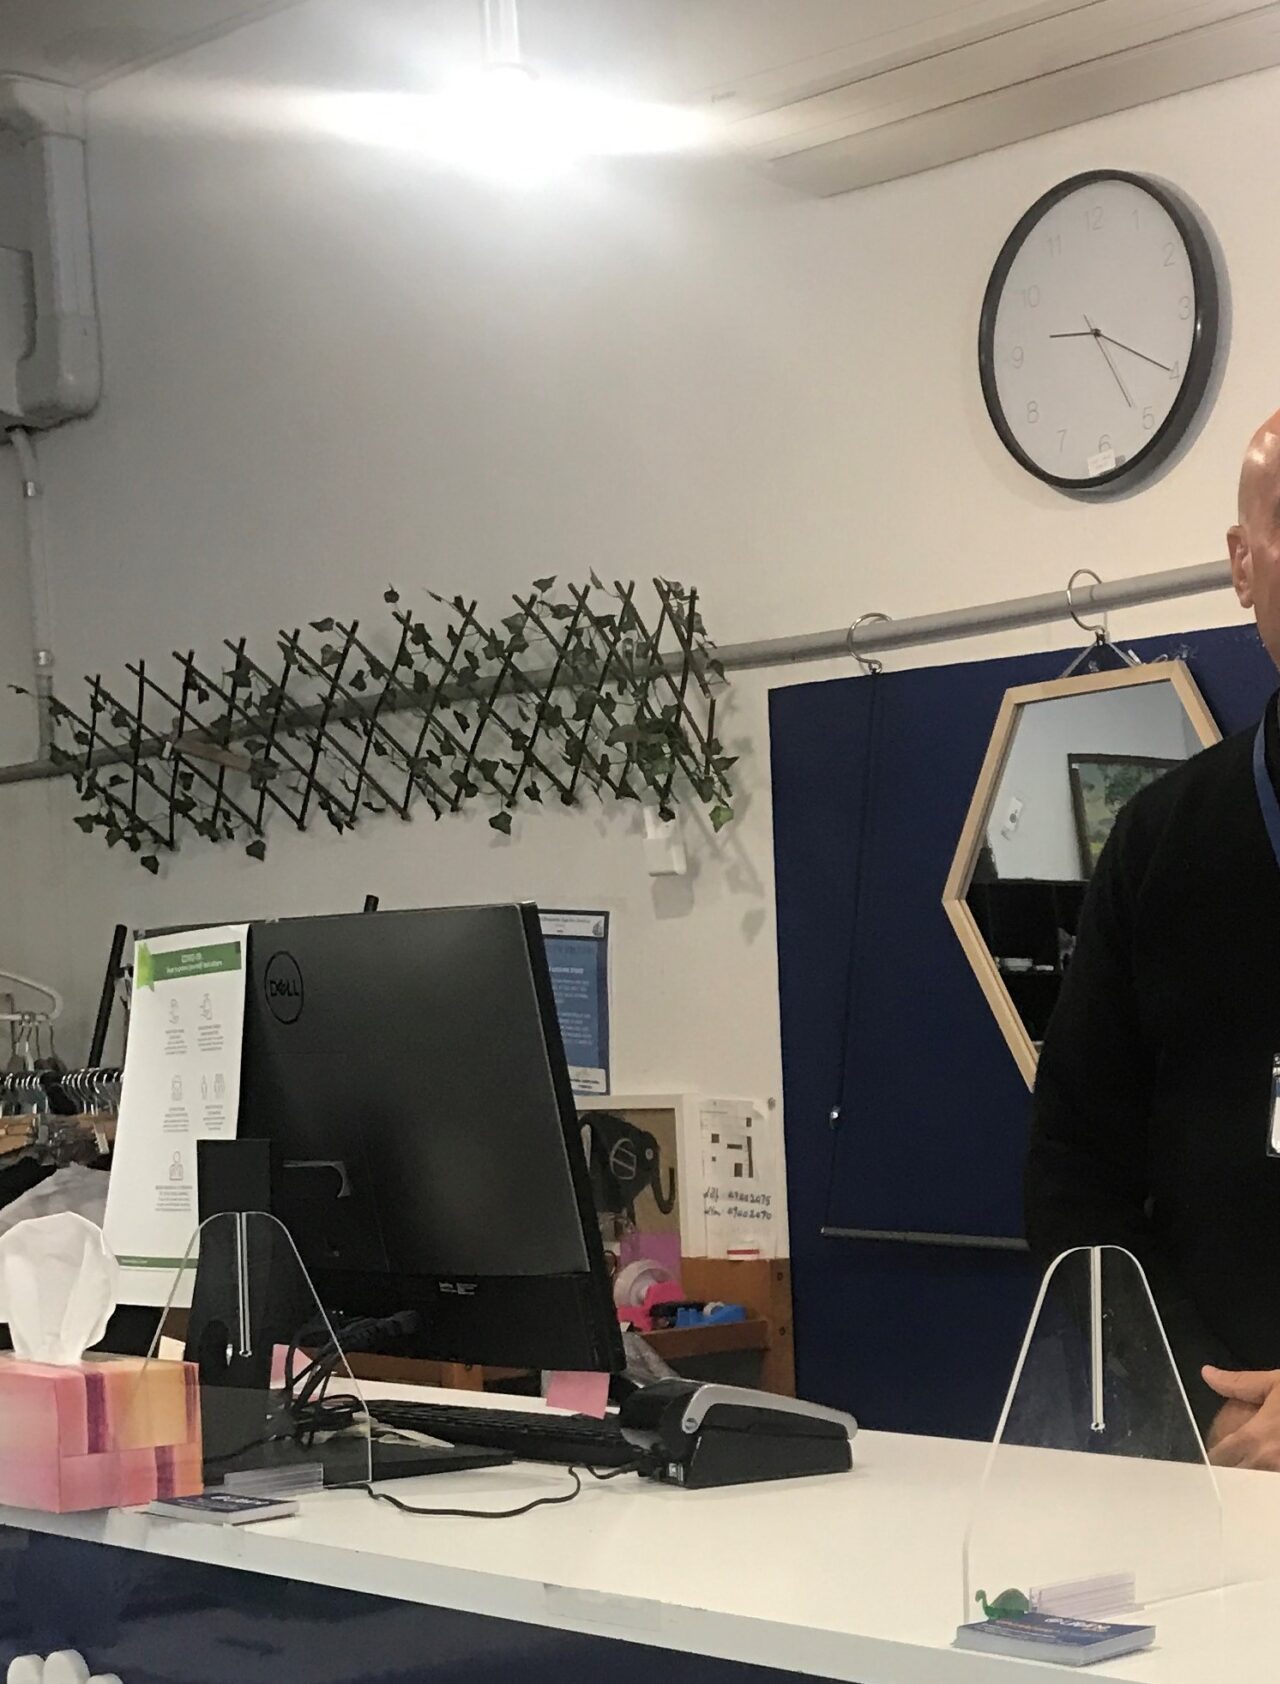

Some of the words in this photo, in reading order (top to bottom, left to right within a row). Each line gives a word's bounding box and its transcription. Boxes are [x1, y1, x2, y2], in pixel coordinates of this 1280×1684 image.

[1085, 206, 1103, 231] 12
[1132, 209, 1140, 231] 1
[1048, 234, 1062, 256] 11
[1162, 242, 1176, 267] 2
[1021, 285, 1041, 308] 10
[1178, 296, 1191, 320] 3
[1012, 346, 1024, 369] 9
[1169, 360, 1180, 381] 4
[1026, 400, 1040, 424] 8
[1142, 406, 1155, 430] 5
[1057, 429, 1069, 452] 7
[1098, 434, 1112, 453] 6
[270, 979, 299, 997] DELL
